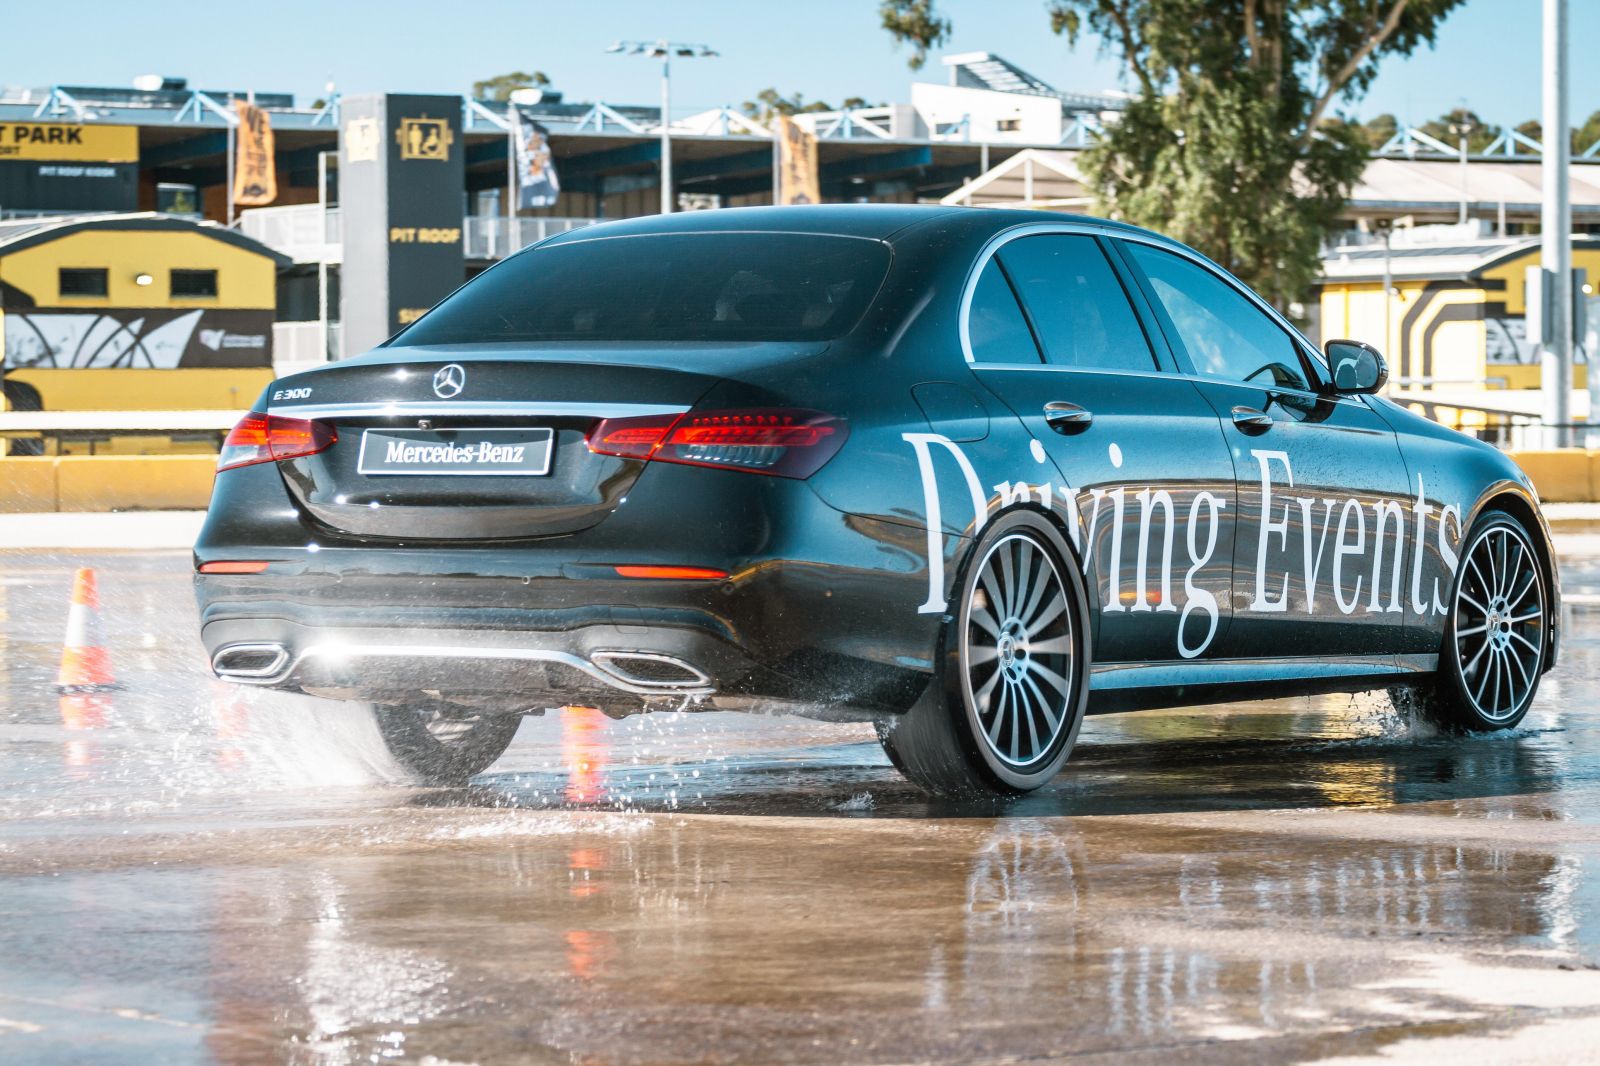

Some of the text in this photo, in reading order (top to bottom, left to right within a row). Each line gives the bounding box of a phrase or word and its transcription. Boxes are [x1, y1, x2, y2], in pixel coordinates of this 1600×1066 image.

[14, 126, 82, 144] PARK
[390, 227, 461, 243] PIT ROOF
[385, 441, 524, 463] Mercedes-Benz
[902, 433, 1463, 658] Dving Events
